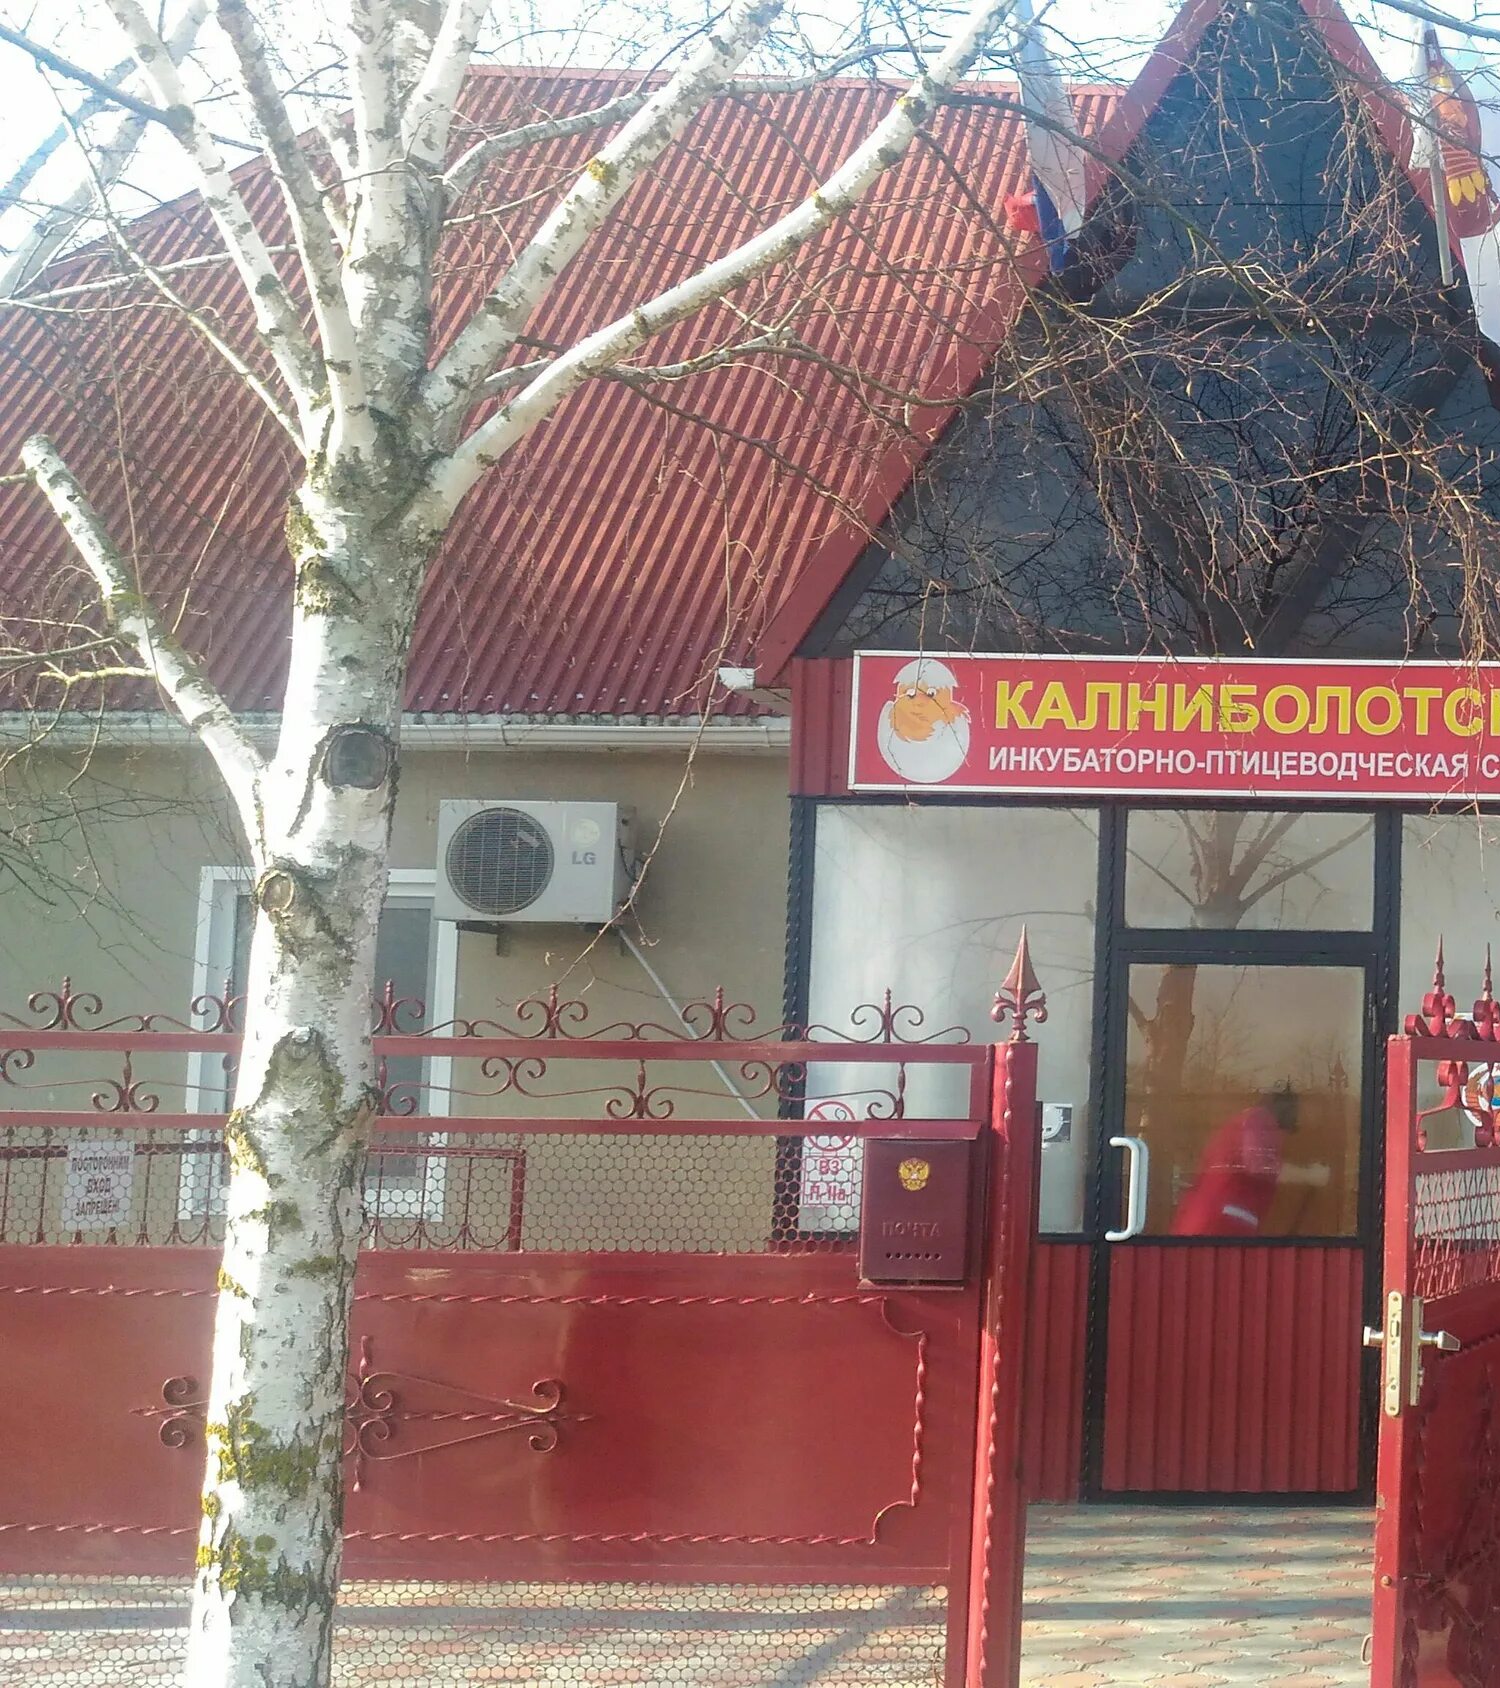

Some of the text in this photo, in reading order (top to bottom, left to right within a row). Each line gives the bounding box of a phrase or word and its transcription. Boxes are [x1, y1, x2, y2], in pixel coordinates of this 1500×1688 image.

[988, 746, 1468, 782] ИНКУБАТОРНО-ПТИЦЕВОДЧЕСКАЯ
[571, 851, 597, 865] LG
[882, 1221, 941, 1238] ПОЧТА
